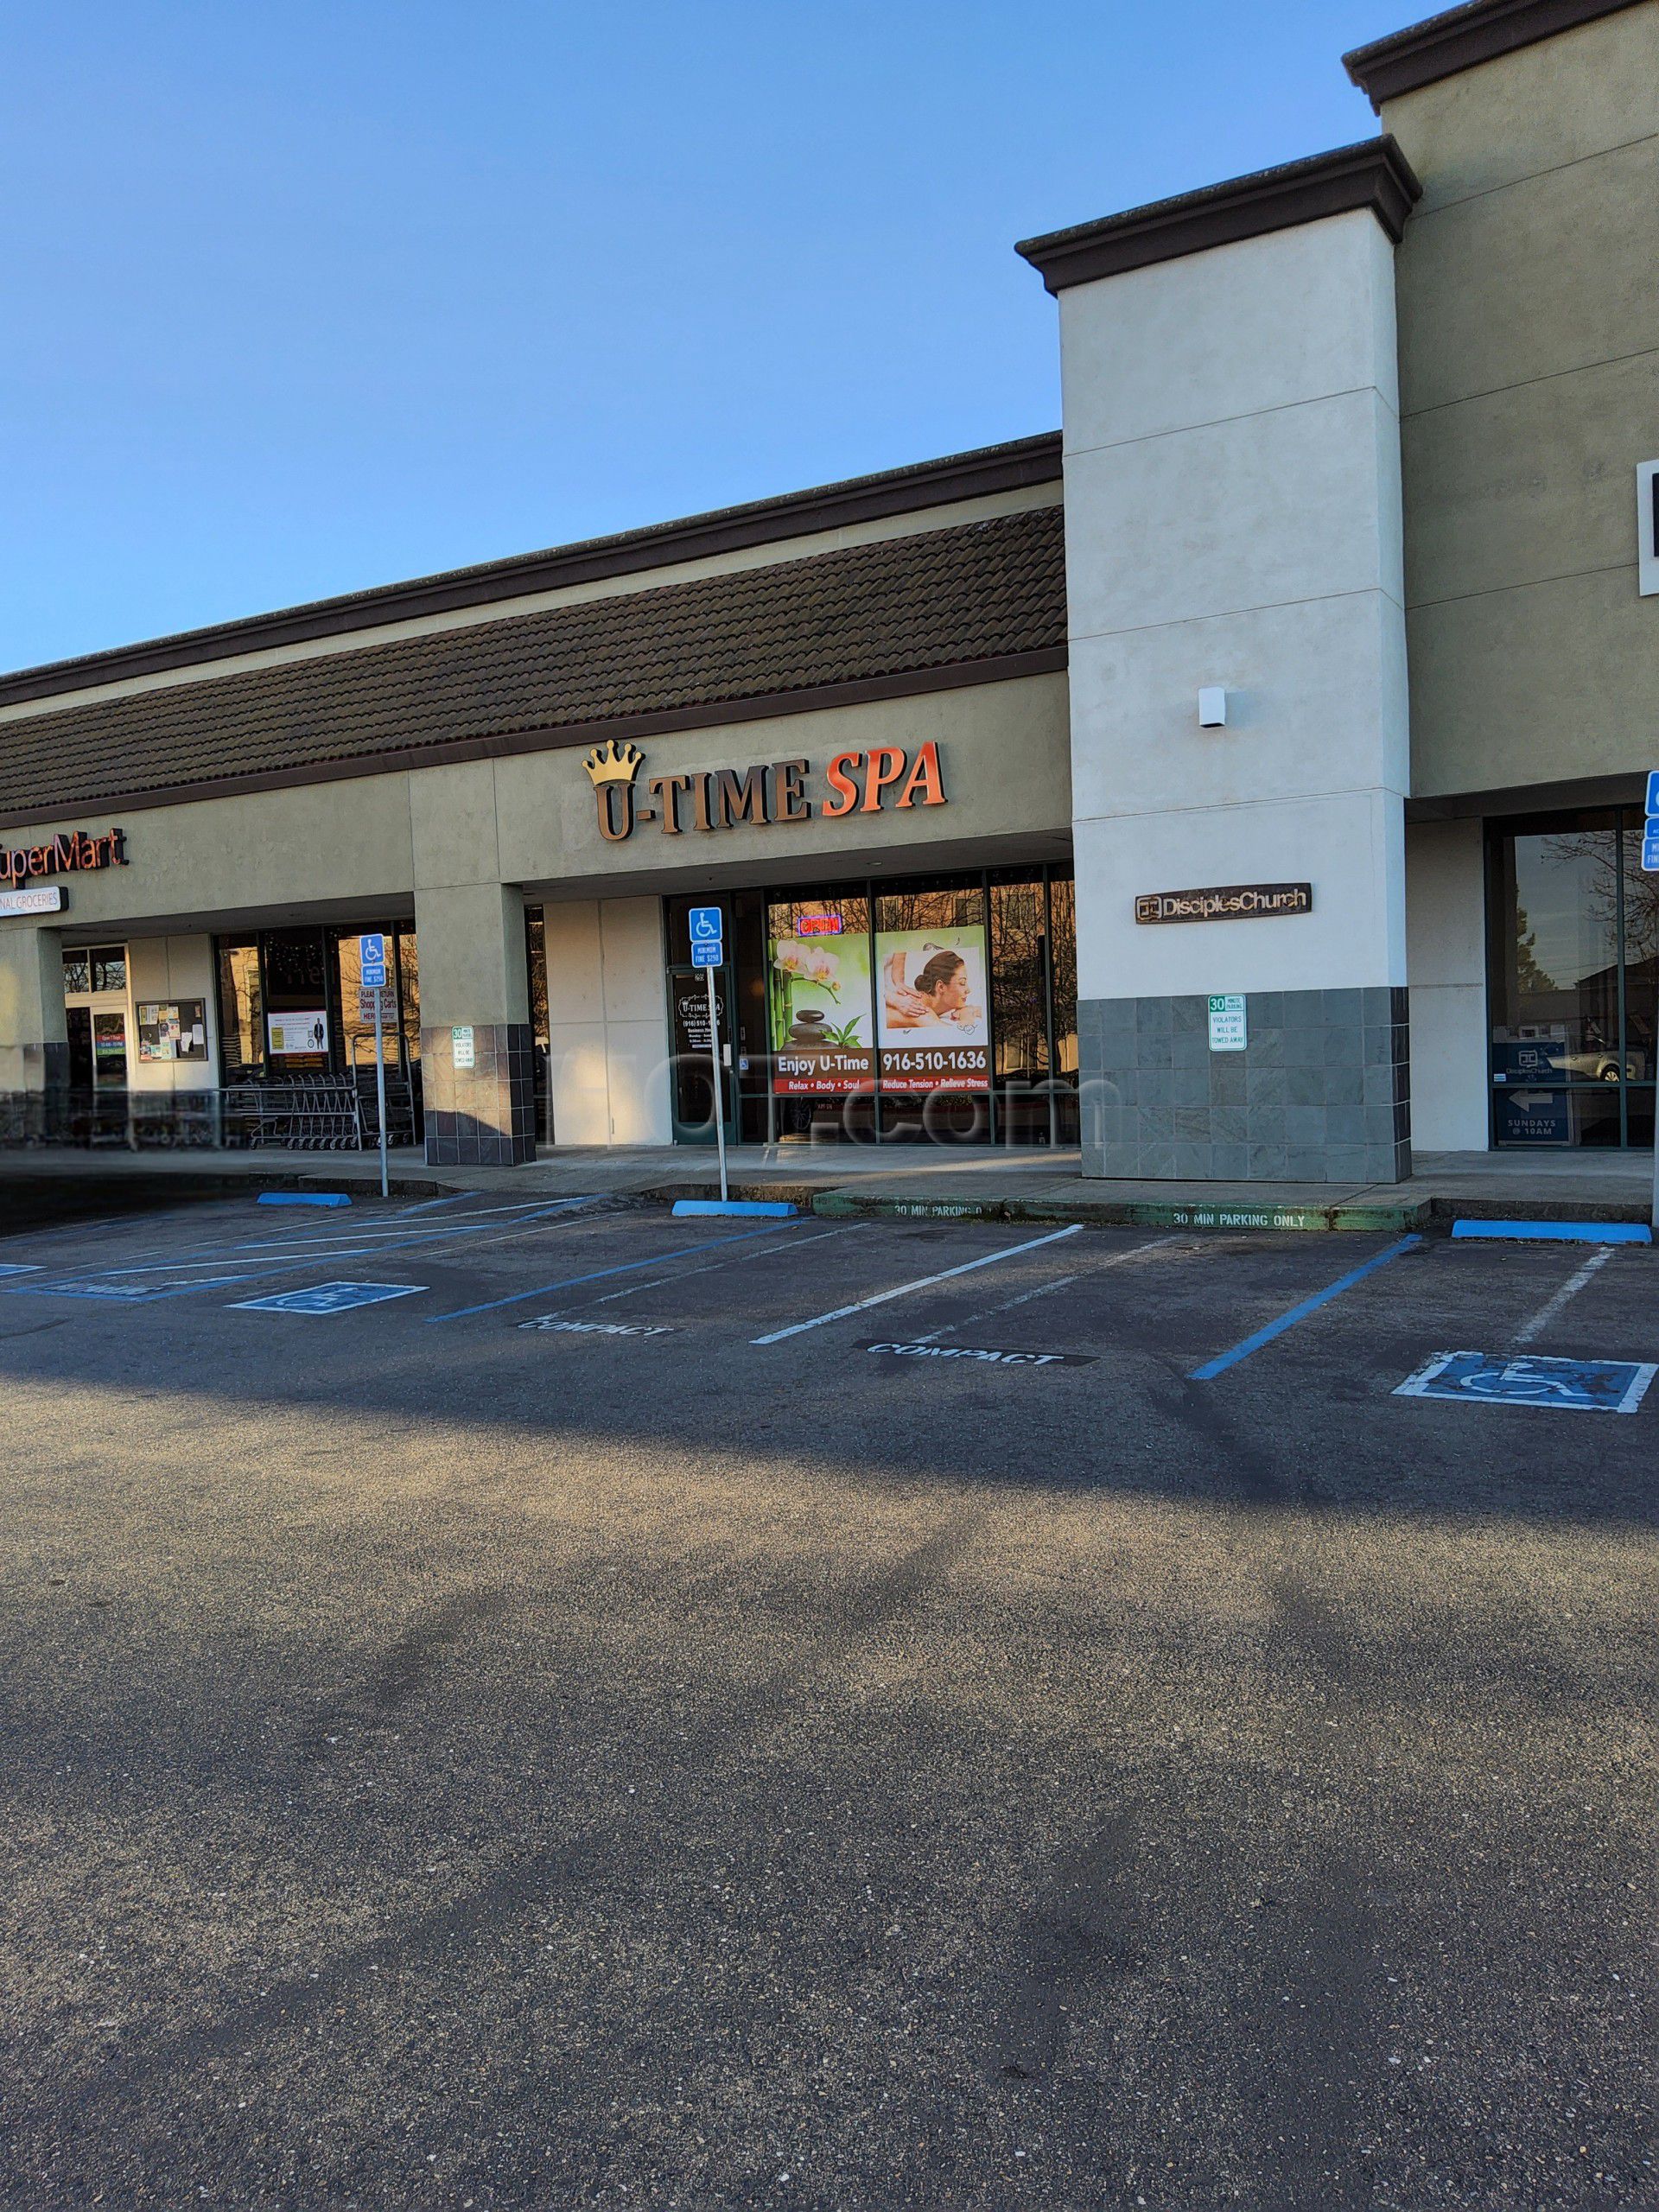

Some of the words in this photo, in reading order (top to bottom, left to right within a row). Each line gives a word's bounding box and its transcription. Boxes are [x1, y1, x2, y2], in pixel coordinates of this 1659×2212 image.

[593, 759, 811, 841] U-TIME
[822, 741, 949, 817] SPA
[0, 828, 130, 889] uperMart
[1647, 855, 1659, 864] FIN
[0, 897, 15, 910] NAL
[16, 893, 58, 909] GROCERIES
[1163, 888, 1306, 918] DisciplesChurch
[683, 1003, 707, 1012] U-TIME
[1210, 998, 1224, 1011] 30
[454, 1028, 462, 1039] 30
[778, 1055, 816, 1077] Enjoy
[820, 1054, 869, 1071] U-Time
[882, 1051, 987, 1071] 916-510-1636
[788, 1080, 809, 1091] Relax
[817, 1079, 836, 1091] Body
[843, 1078, 860, 1090] Soul
[882, 1078, 907, 1090] Reduce
[909, 1078, 933, 1089] Tension
[940, 1077, 966, 1089] Relieve
[967, 1077, 988, 1088] Stress
[1508, 1119, 1556, 1128] SUNDAYS
[1524, 1127, 1553, 1135] 10AM
[894, 1205, 907, 1217] 30
[911, 1205, 928, 1217] MIN
[1173, 1212, 1188, 1225] 30
[1193, 1213, 1215, 1226] MIN
[1219, 1213, 1268, 1227] PARKING
[1273, 1214, 1306, 1228] ONLY
[518, 1320, 675, 1336] COMPACT
[866, 1343, 1065, 1366] COMPACT
